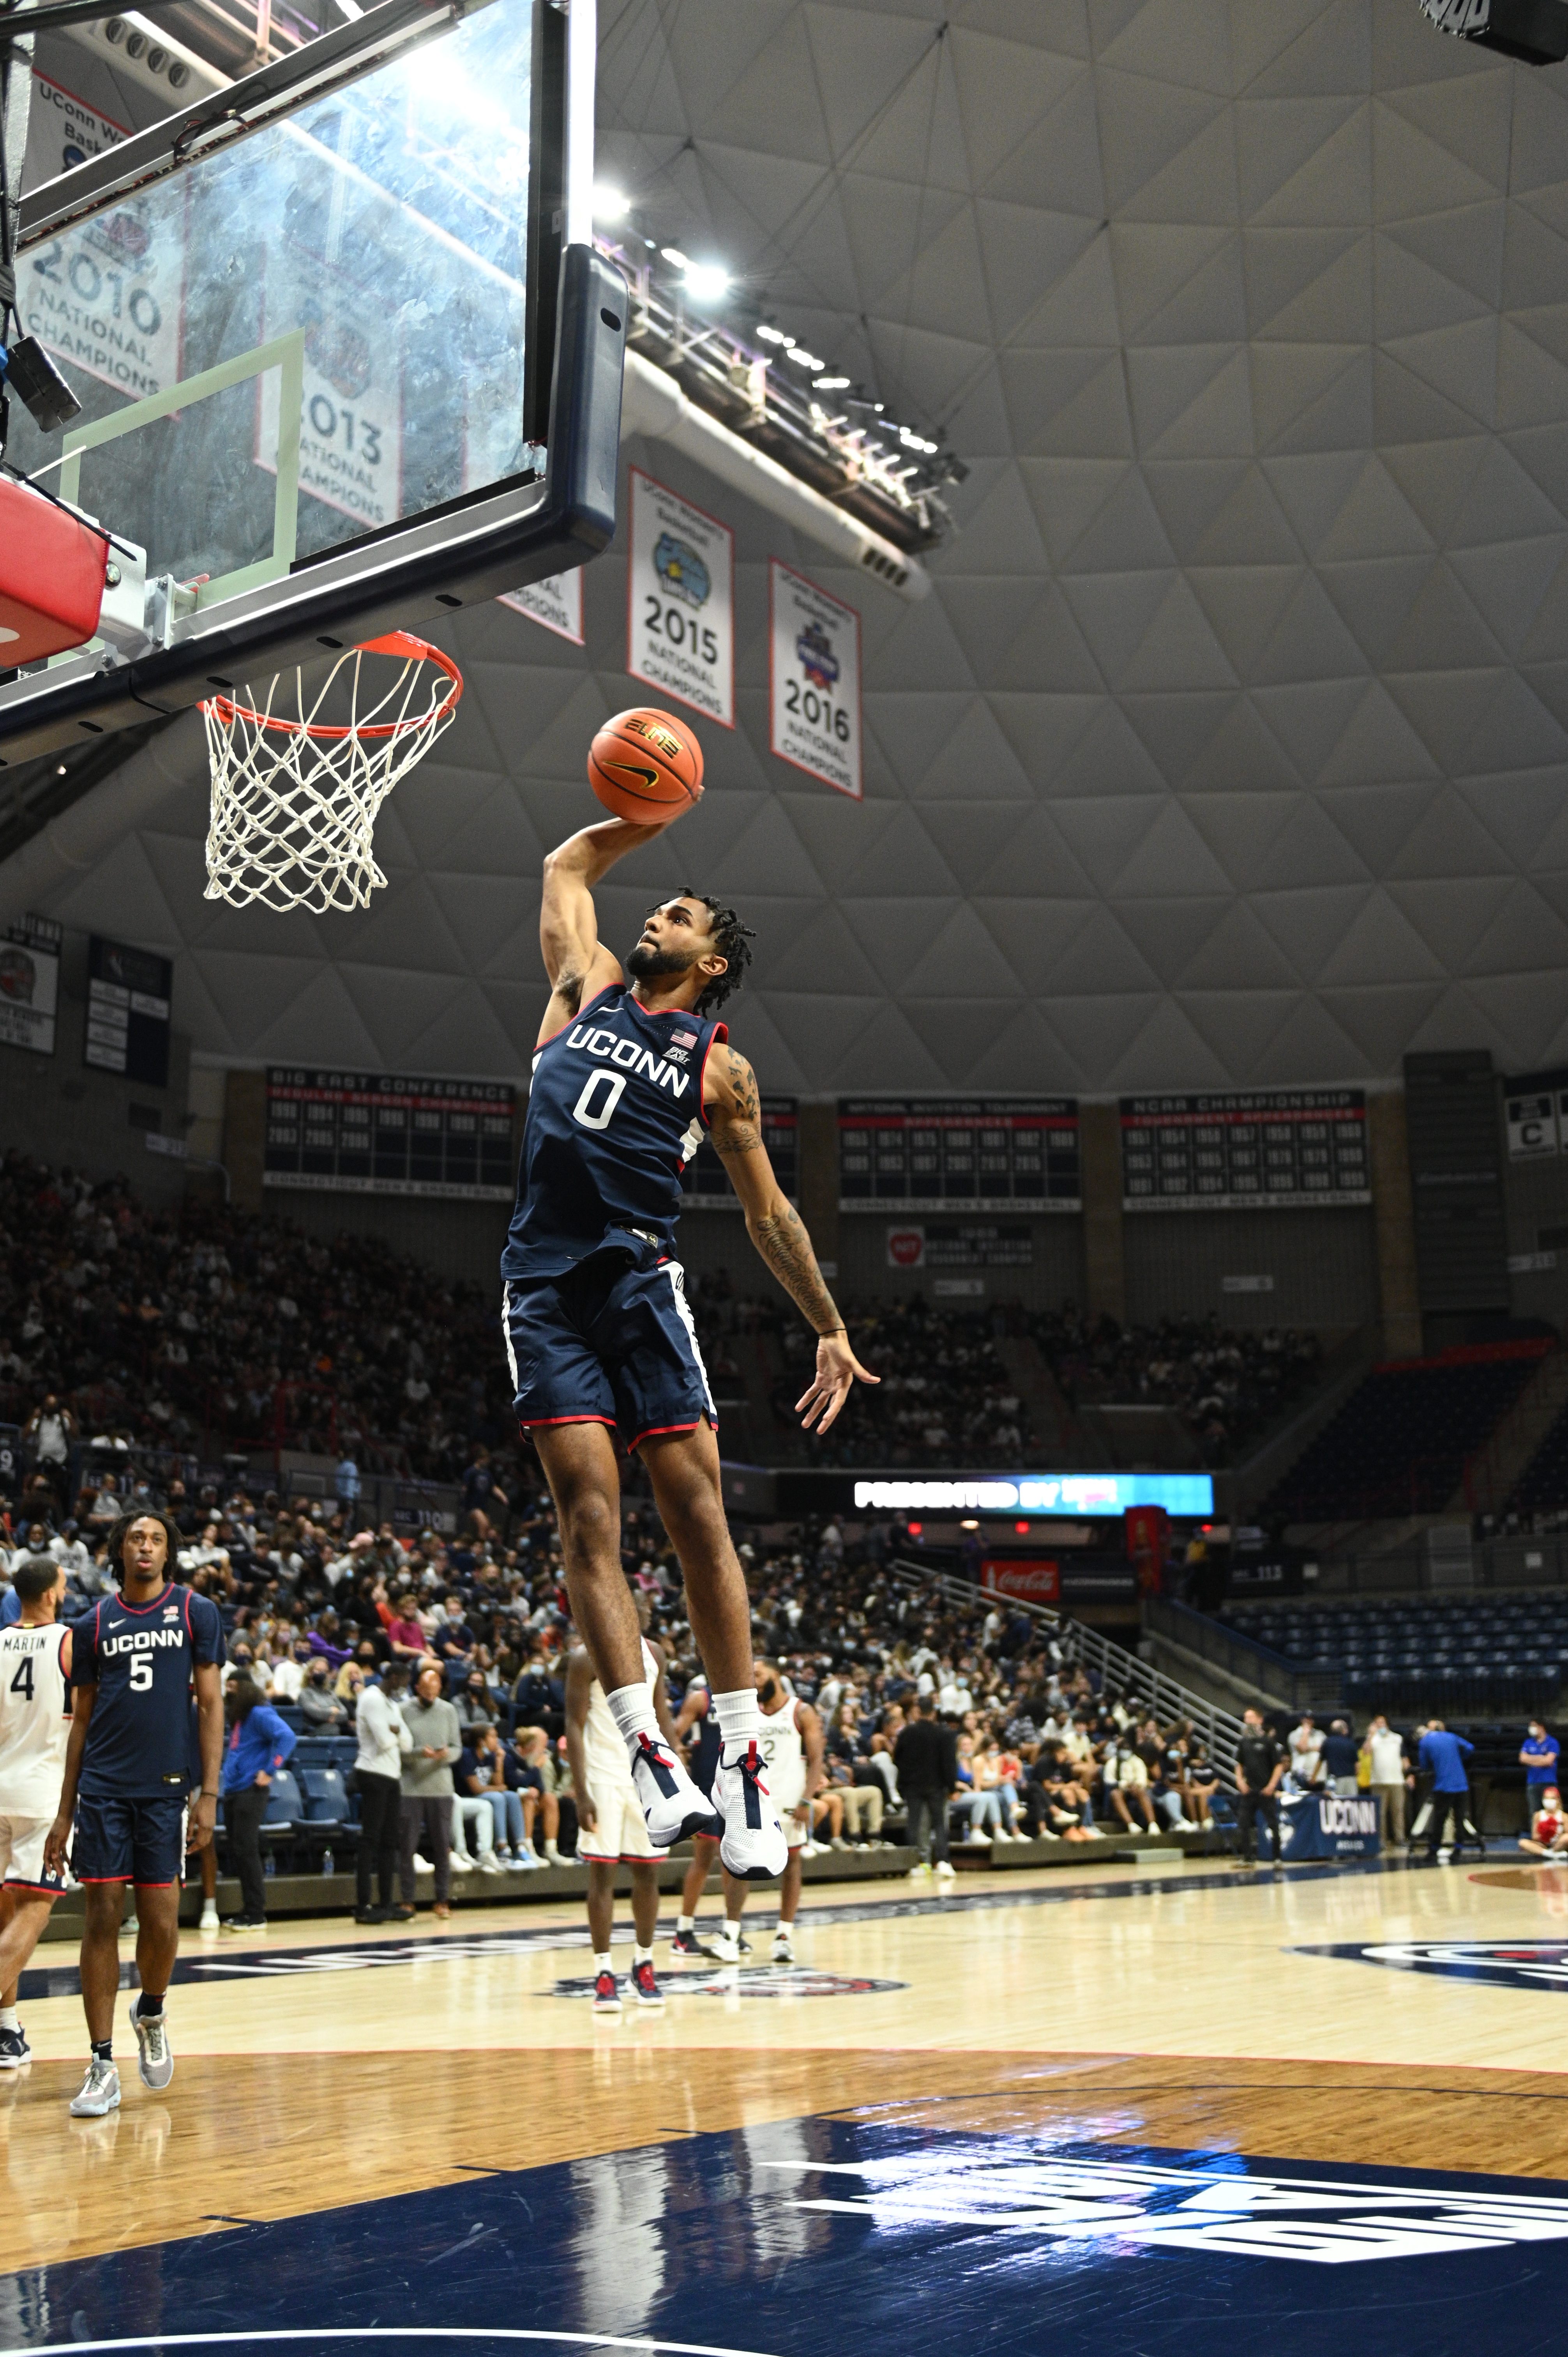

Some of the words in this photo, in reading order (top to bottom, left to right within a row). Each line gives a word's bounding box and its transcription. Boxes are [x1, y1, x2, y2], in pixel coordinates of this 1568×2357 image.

[40, 82, 95, 130] UConn
[33, 240, 161, 336] 2010
[40, 288, 151, 366] NATIONAL
[28, 313, 159, 395] CHAMPIONS
[302, 393, 382, 465] 013
[300, 437, 377, 494] ATIONAL
[301, 466, 384, 522] AMPIONS
[645, 595, 718, 665] 2015
[641, 659, 722, 715] CHAMPIONS
[648, 640, 717, 689] NATIONAL
[786, 679, 850, 742] 2016
[623, 718, 683, 761] ELITE
[782, 739, 853, 787] CHAMPIONS
[788, 720, 848, 764] NATIONAL
[566, 1024, 690, 1098] UCONN
[664, 1050, 690, 1063] EAST
[669, 1046, 689, 1056] BIG
[273, 1070, 305, 1086] BIG
[316, 1073, 369, 1089] EAST
[380, 1078, 510, 1100] CONFERENCE
[572, 1069, 627, 1129] 0
[1134, 1099, 1187, 1113] NCAA
[1197, 1093, 1351, 1112] CHAMPIONSHIP
[4, 1636, 47, 1652] MARTIN
[102, 1629, 184, 1657] UCONN
[11, 1656, 35, 1701] 4
[129, 1652, 154, 1692] 5
[759, 1726, 792, 1735] CONN
[763, 1739, 775, 1761] 2
[1319, 1798, 1377, 1835] UCONN
